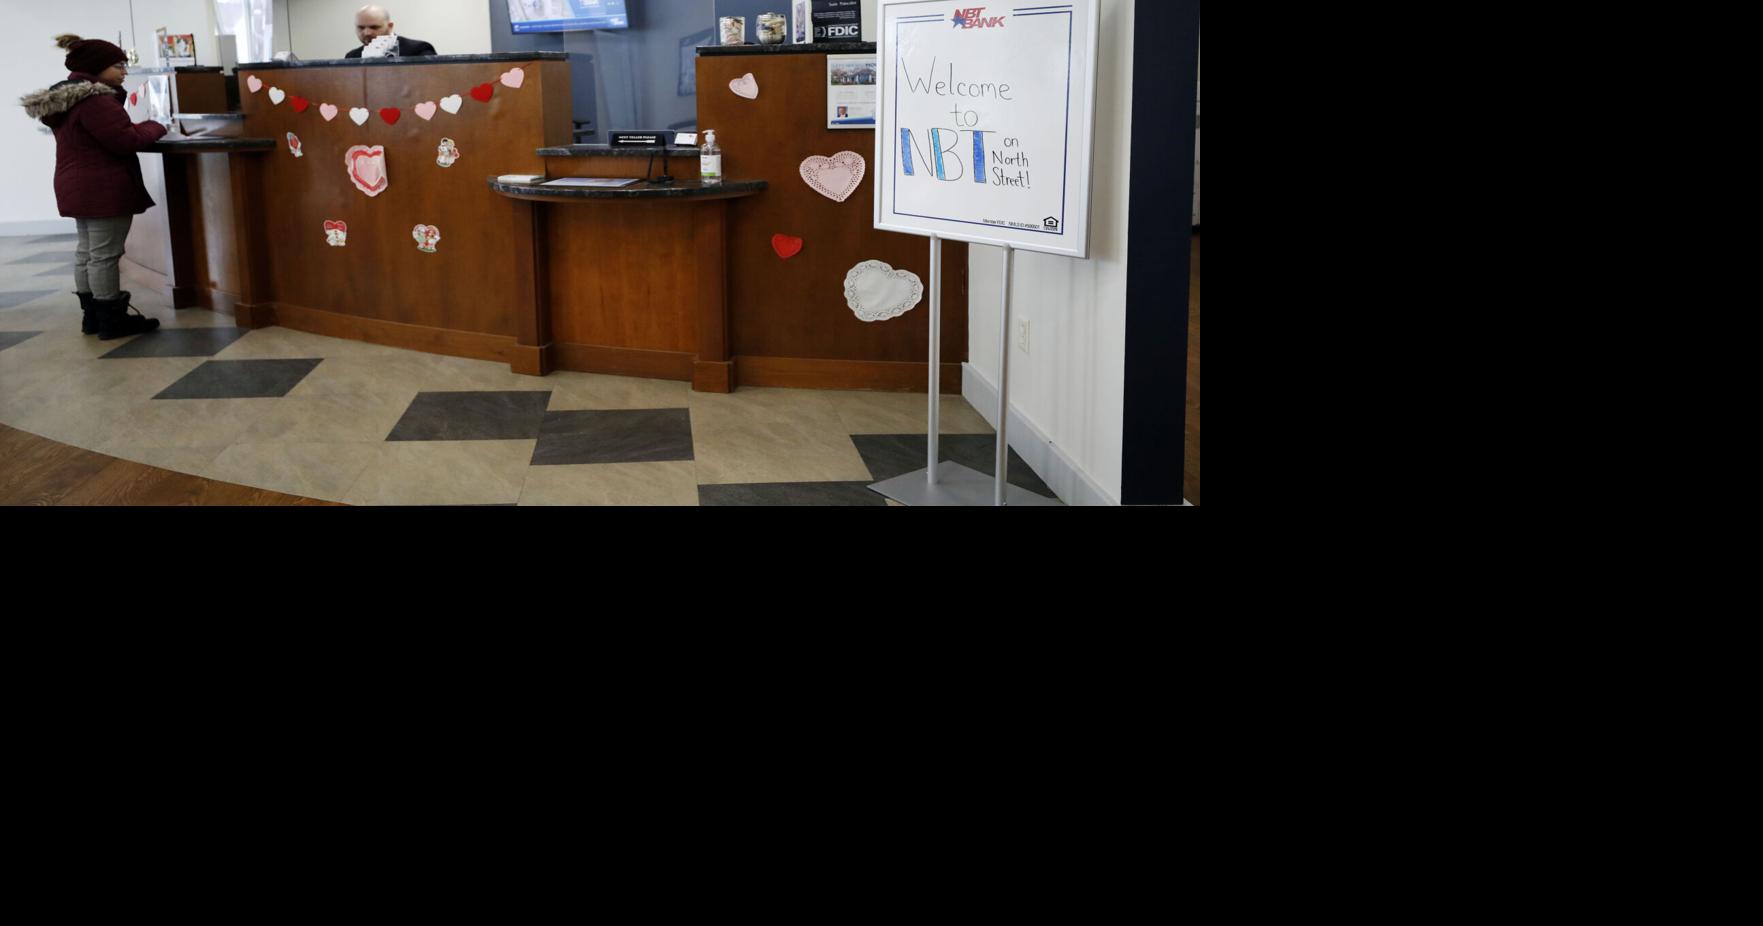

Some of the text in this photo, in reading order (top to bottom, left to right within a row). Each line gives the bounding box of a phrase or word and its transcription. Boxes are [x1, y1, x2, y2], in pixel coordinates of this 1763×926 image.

[953, 7, 986, 19] NBT
[827, 25, 859, 37] FDIC
[961, 16, 1007, 29] BANK
[901, 55, 1013, 101] Welcome
[950, 103, 979, 127] to
[1003, 136, 1019, 148] on
[900, 127, 997, 184] NBT
[992, 150, 1029, 168] North
[992, 166, 1031, 189] Street!
